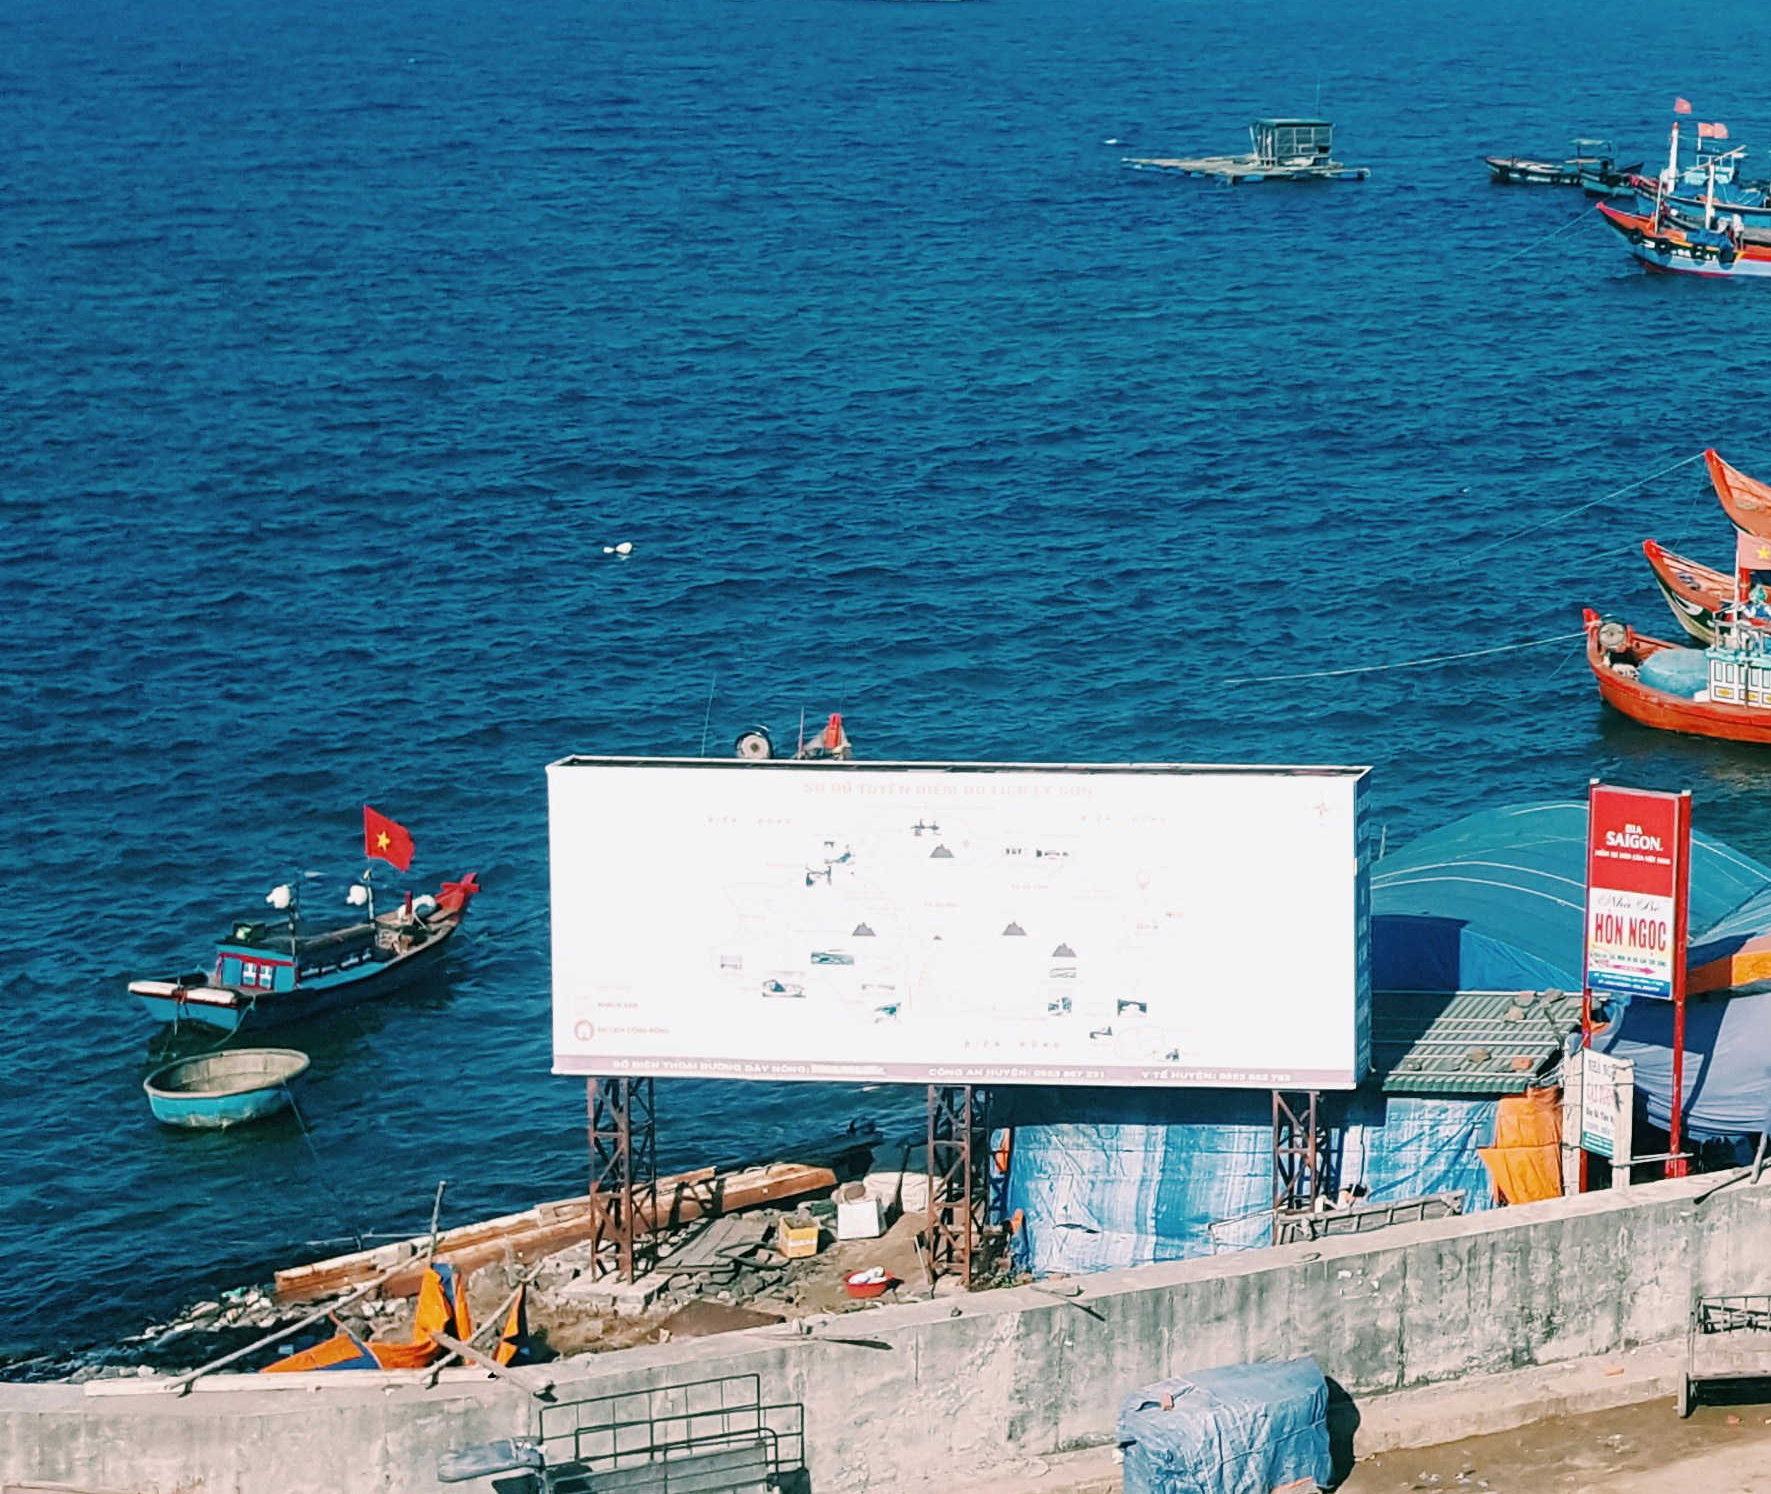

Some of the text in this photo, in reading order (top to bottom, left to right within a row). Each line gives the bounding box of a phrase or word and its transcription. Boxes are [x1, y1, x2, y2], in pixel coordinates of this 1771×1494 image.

[1625, 823, 1643, 835] BIA
[1629, 917, 1667, 957] NGỌC
[966, 1068, 984, 1077] AN
